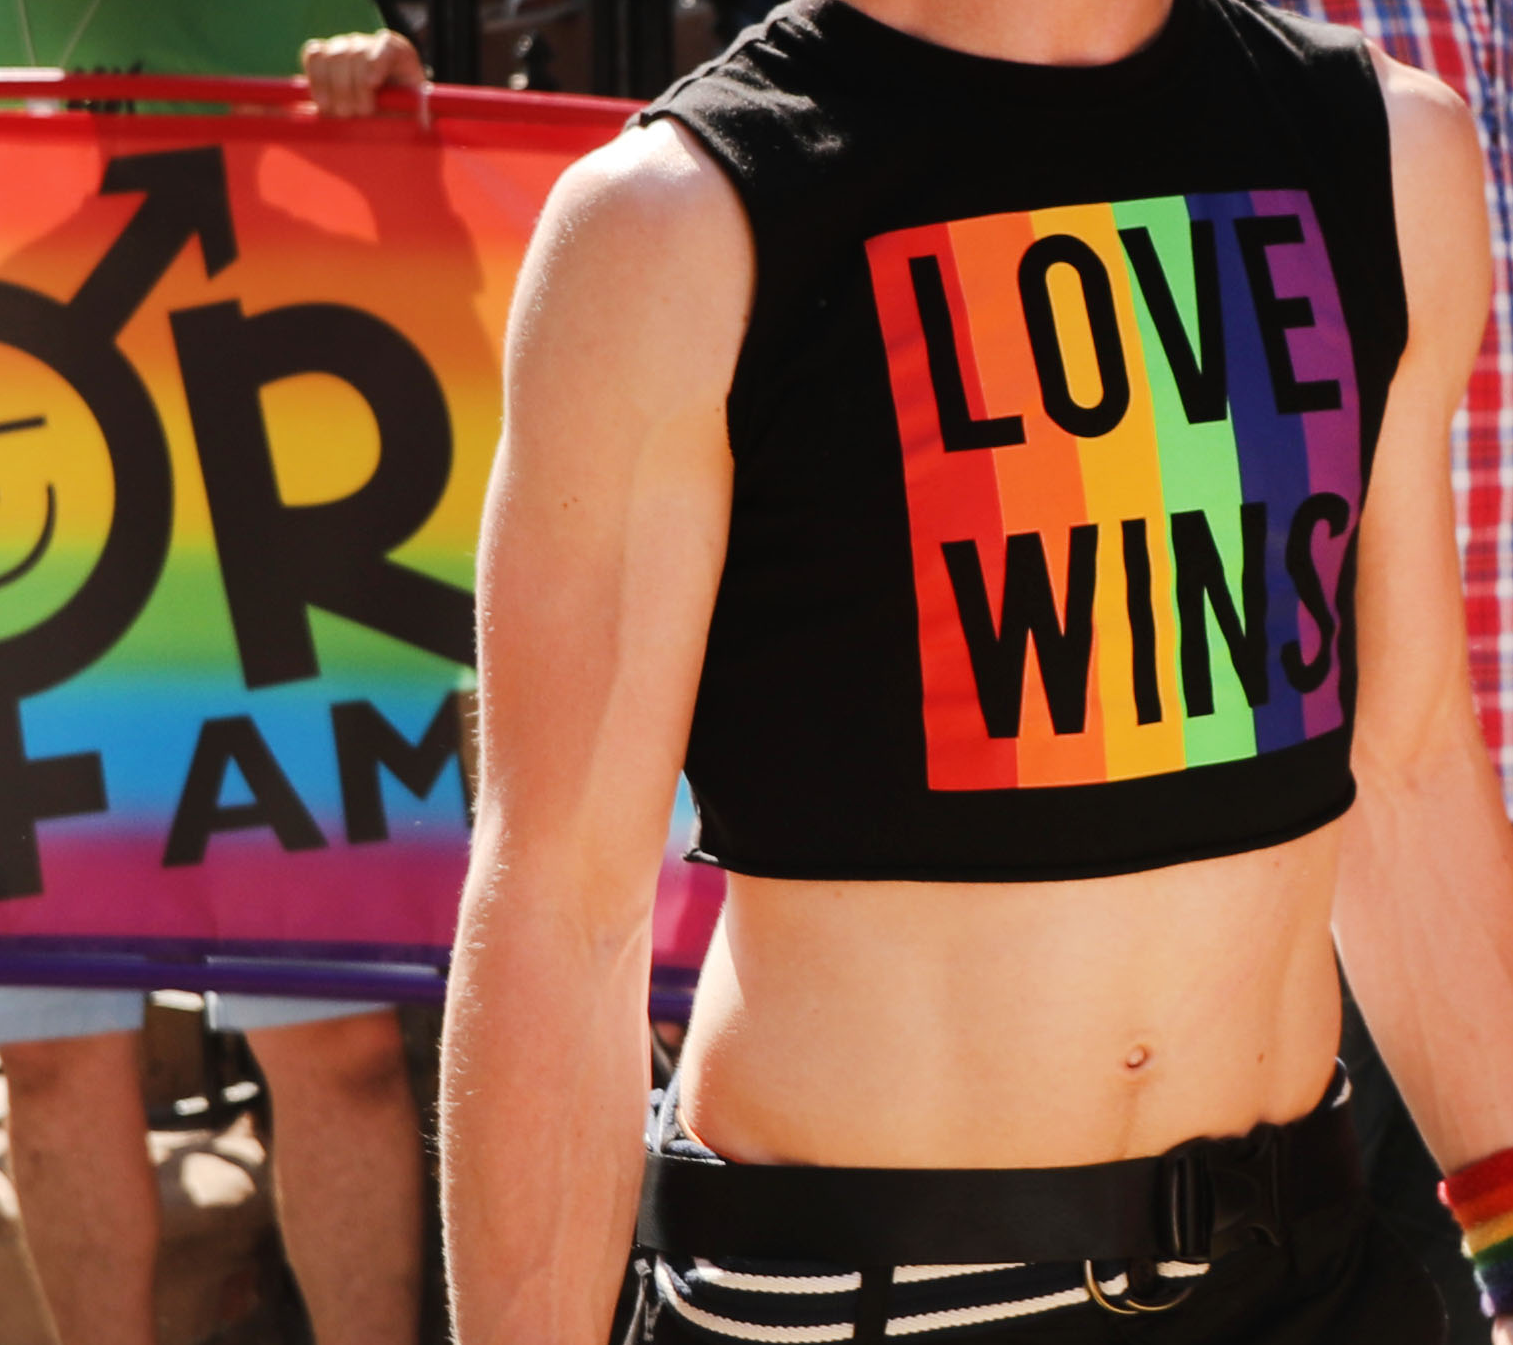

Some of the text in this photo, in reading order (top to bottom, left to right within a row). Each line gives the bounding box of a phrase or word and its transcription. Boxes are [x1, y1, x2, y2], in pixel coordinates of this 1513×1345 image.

[907, 213, 1343, 454] LOVE
[939, 490, 1352, 740] WINS
[160, 688, 477, 869] AM
